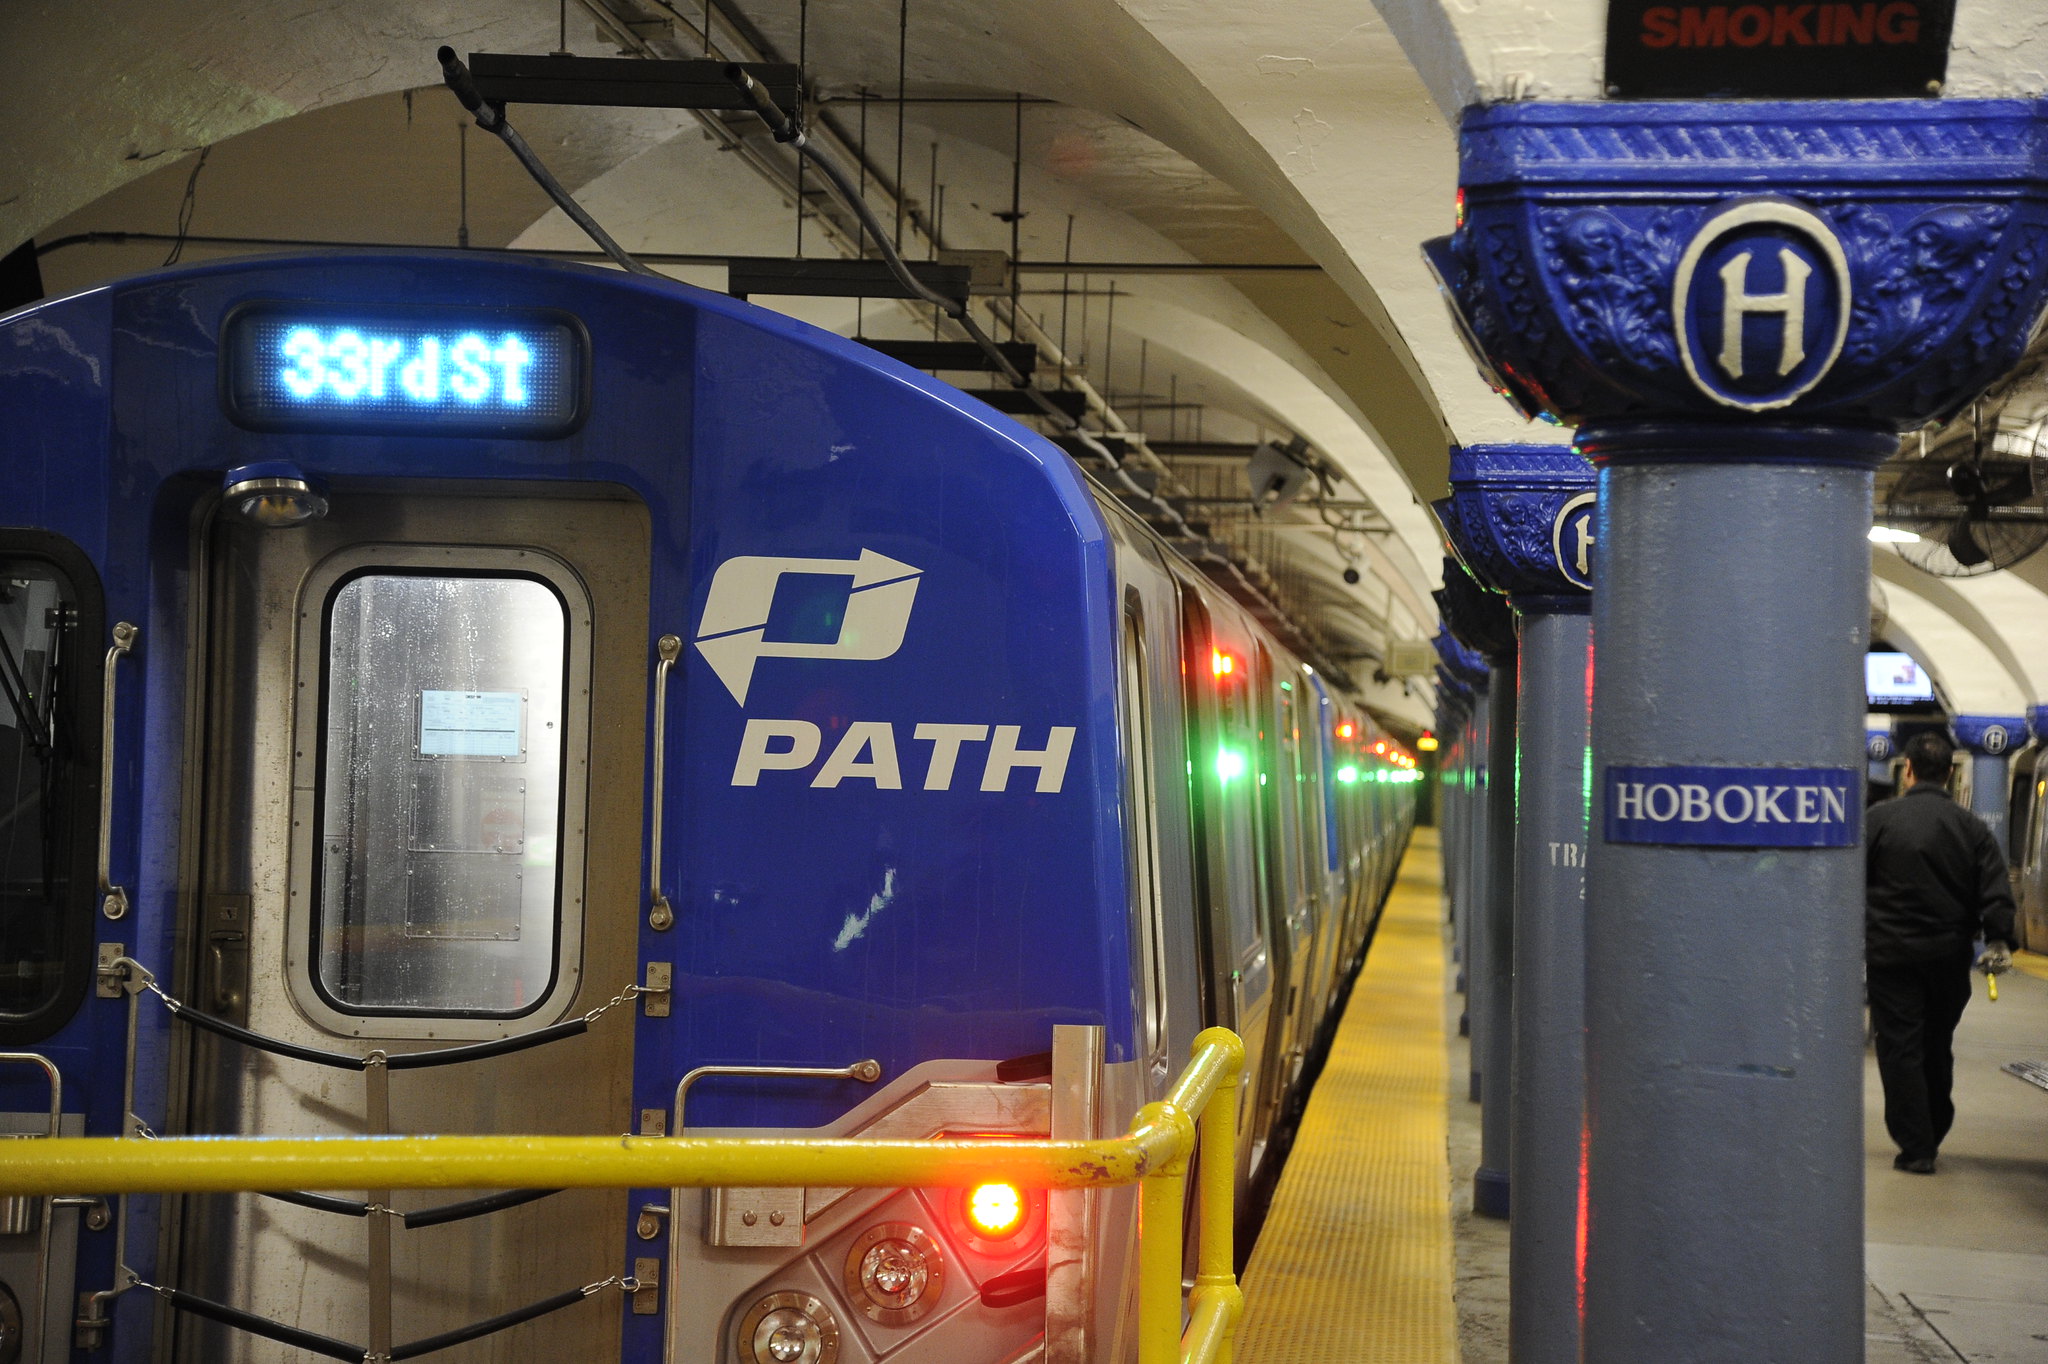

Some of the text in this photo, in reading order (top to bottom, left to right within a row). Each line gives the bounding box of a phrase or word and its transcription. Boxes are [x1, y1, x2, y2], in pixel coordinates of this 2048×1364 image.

[1640, 2, 1921, 49] SMOKING
[1718, 247, 1813, 380] H
[730, 718, 1077, 794] PATH
[1616, 782, 1847, 824] HOBOKEN
